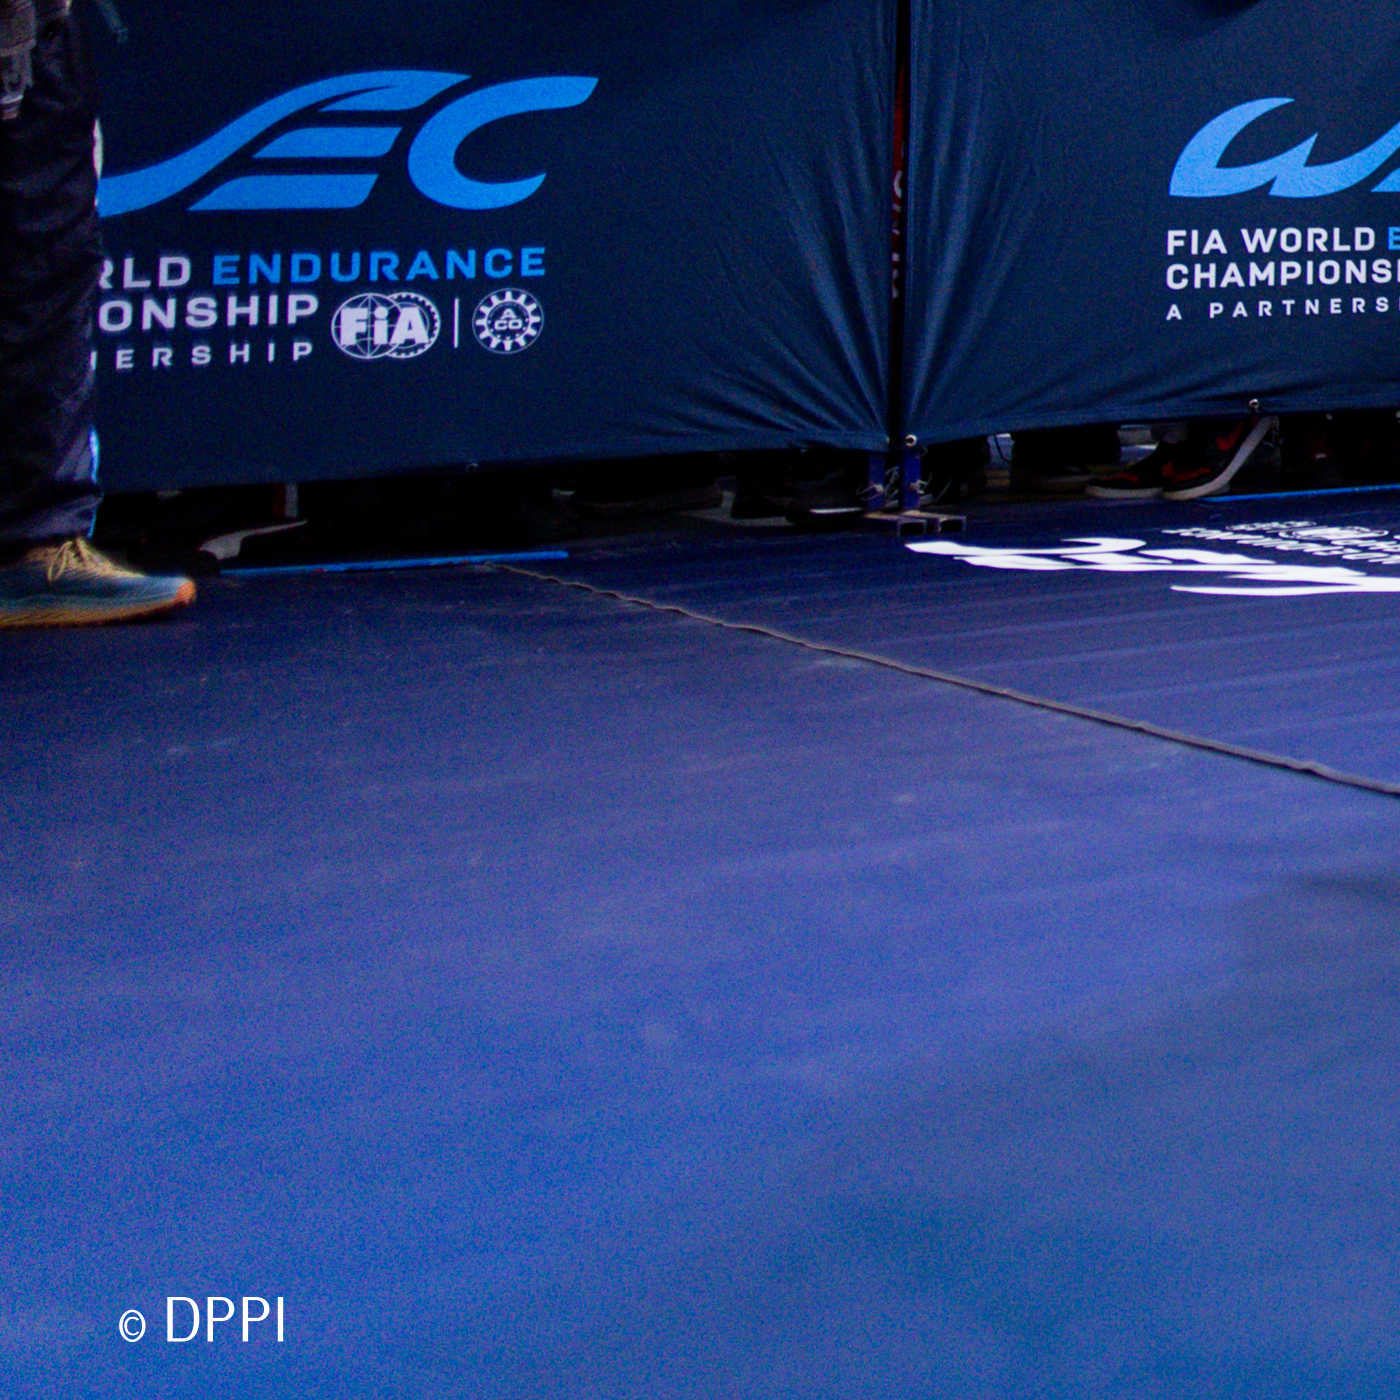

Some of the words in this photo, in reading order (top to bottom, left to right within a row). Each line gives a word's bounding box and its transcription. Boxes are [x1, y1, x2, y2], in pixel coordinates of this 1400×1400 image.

[1167, 228, 1227, 256] FIA
[1241, 226, 1376, 255] WORLD
[212, 246, 547, 286] ENDURANCE
[1166, 303, 1182, 321] A
